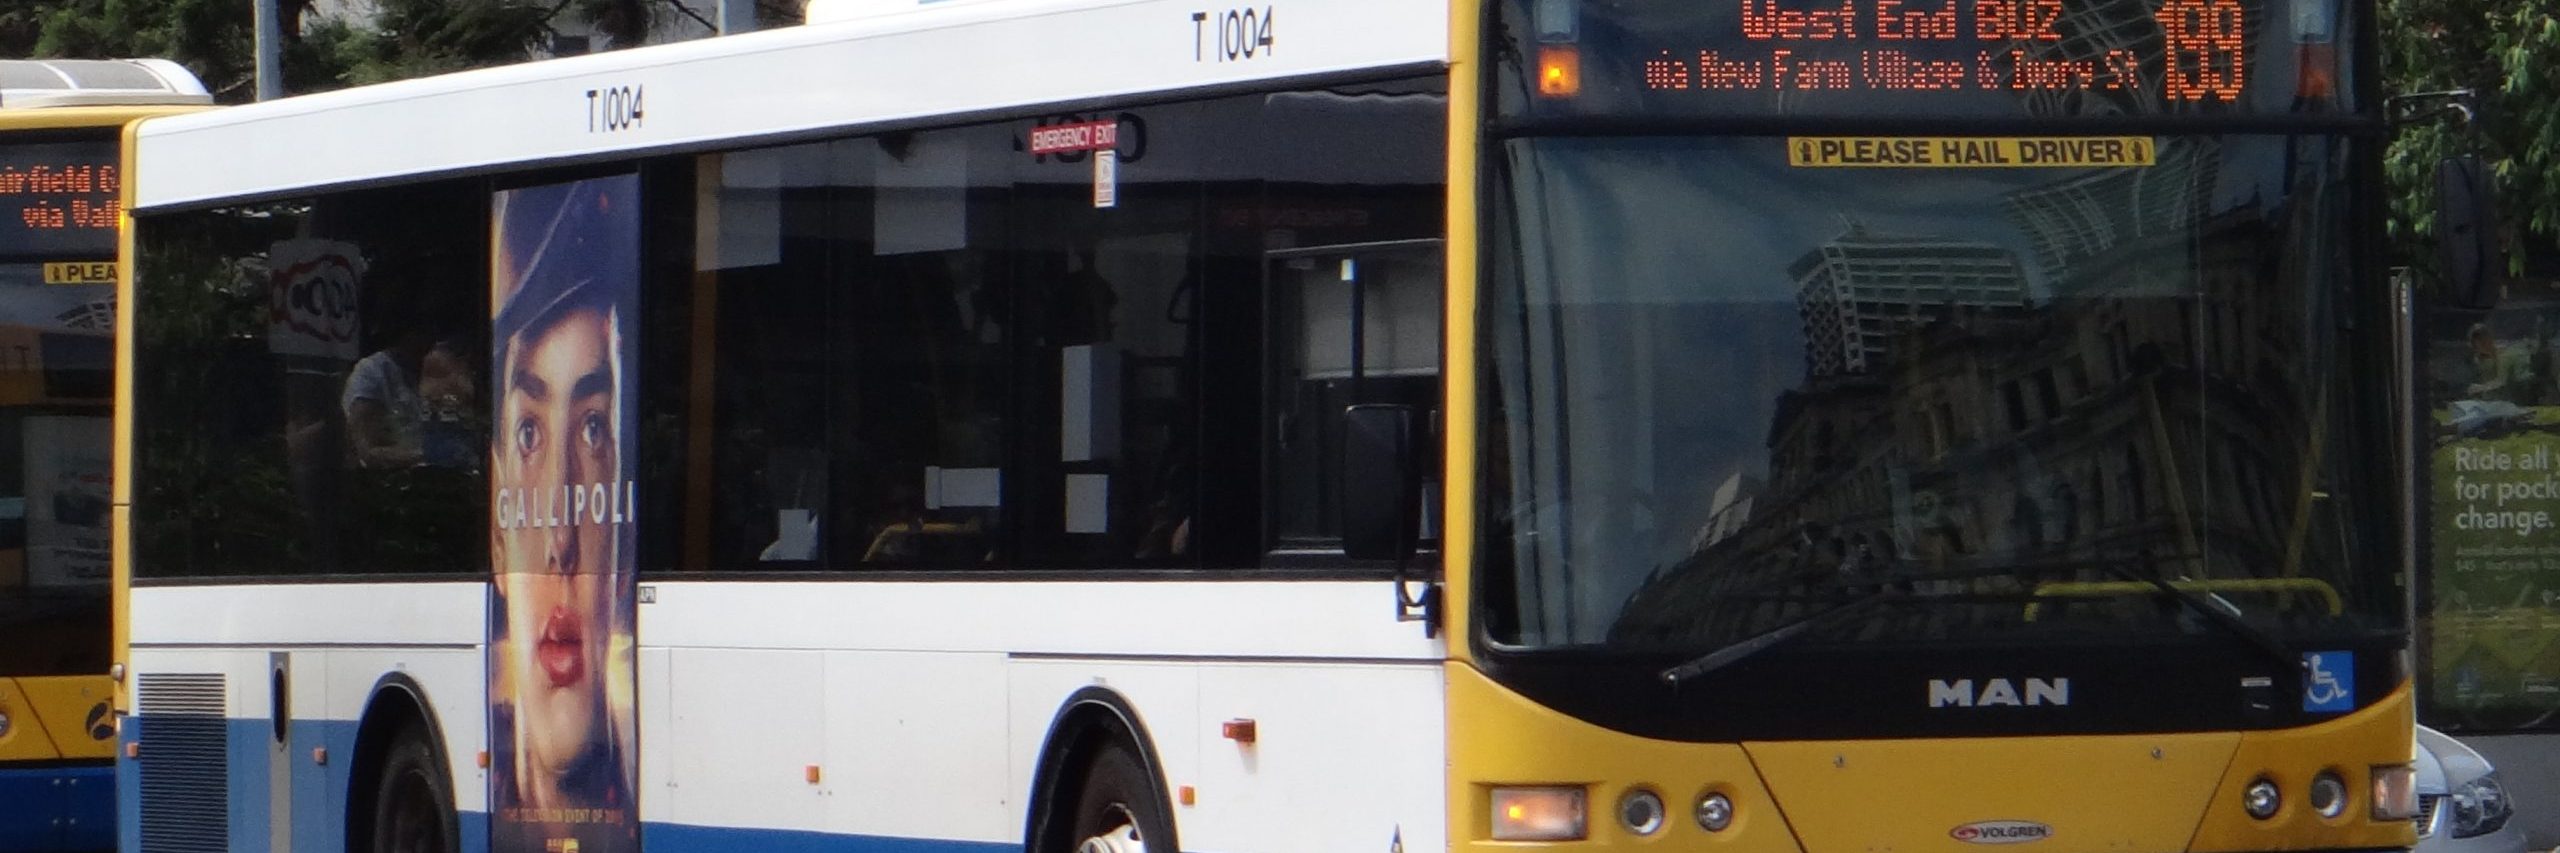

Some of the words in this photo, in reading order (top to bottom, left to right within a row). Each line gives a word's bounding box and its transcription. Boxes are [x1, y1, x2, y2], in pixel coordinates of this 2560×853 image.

[1743, 0, 1857, 39] West
[1877, 0, 1956, 39] End
[1976, 0, 2062, 39] BUZ
[2154, 0, 2243, 99] 199
[1646, 50, 1688, 88] via
[1701, 50, 1761, 88] New
[1774, 50, 1850, 88] Farm
[1862, 50, 1965, 88] Village
[1977, 50, 1999, 88] &
[2011, 50, 2094, 88] Ivory
[2105, 50, 2138, 88] St
[1032, 126, 1091, 151] EMERGENCY
[1096, 123, 1117, 144] EXIT
[1820, 140, 1932, 163] PLEASE
[1942, 140, 2009, 163] HAIL
[2019, 140, 2125, 163] DRIVER
[23, 200, 64, 228] via
[2456, 446, 2511, 471] Ride
[2520, 444, 2548, 470] all
[497, 480, 634, 529] GALLIPOLI
[2456, 475, 2491, 500] for
[2498, 474, 2560, 506] pock
[2456, 504, 2554, 536] change.
[1929, 678, 2068, 707] MAN
[1981, 825, 2047, 839] VOLGREN
